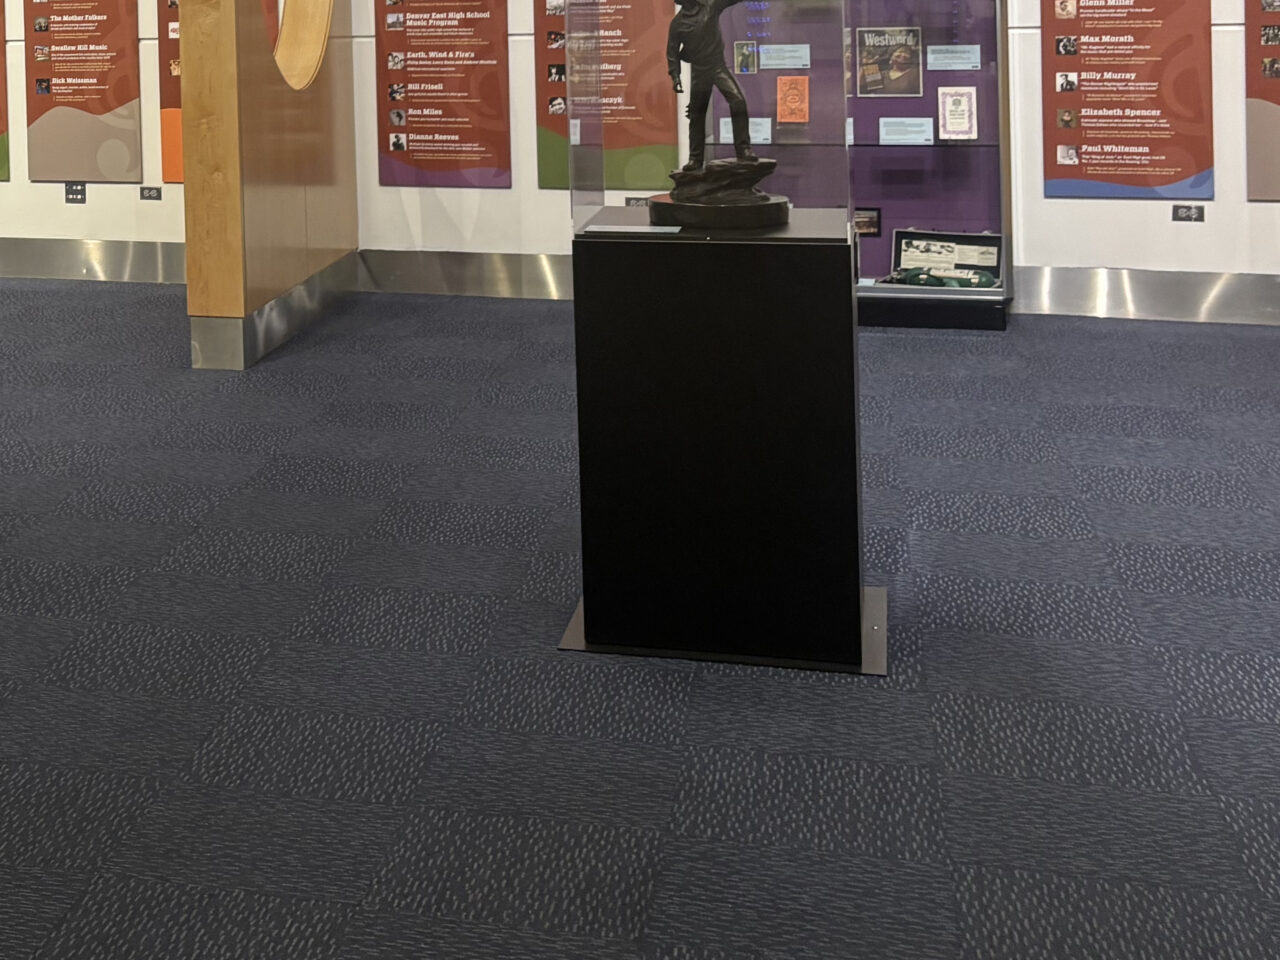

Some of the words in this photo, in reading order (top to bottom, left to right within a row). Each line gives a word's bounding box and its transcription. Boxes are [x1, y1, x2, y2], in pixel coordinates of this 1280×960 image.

[428, 19, 458, 27] Program
[864, 33, 914, 46] Westword
[1080, 72, 1101, 80] Billy
[1103, 72, 1136, 80] Murray
[1125, 109, 1161, 118] Spencer
